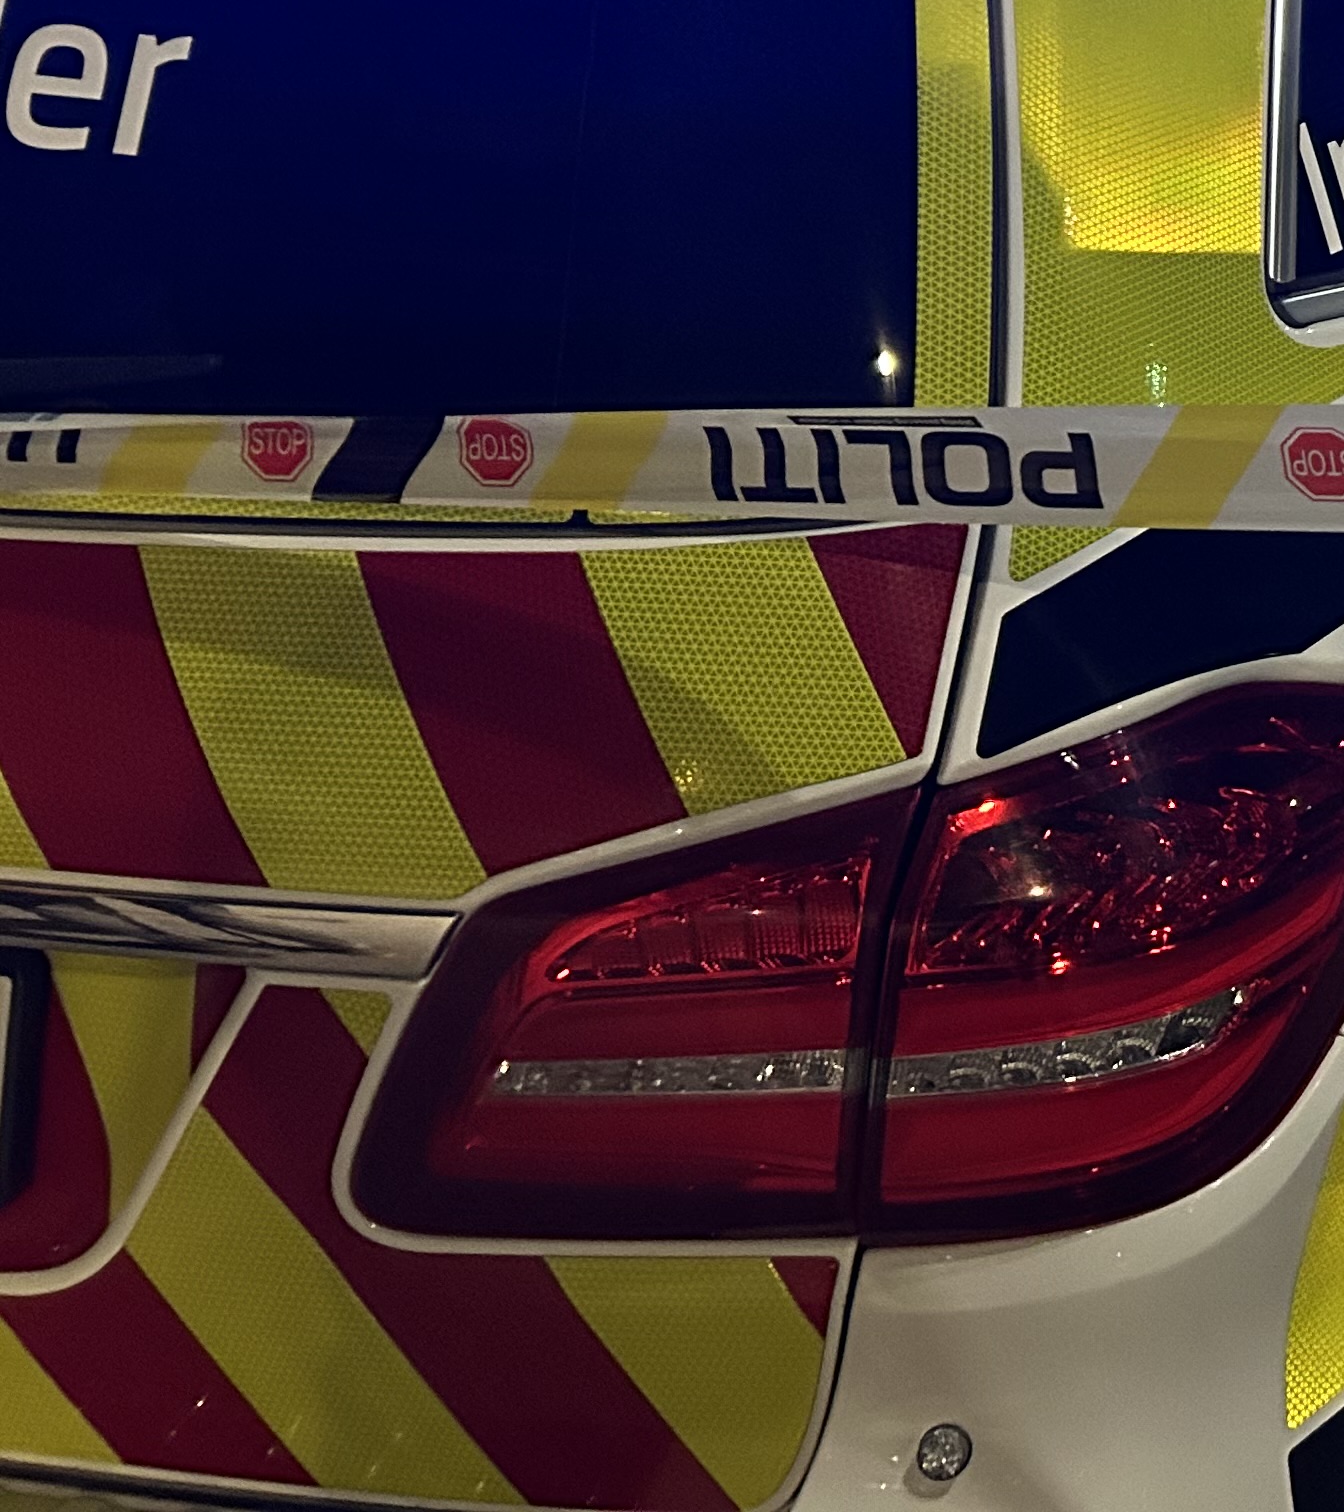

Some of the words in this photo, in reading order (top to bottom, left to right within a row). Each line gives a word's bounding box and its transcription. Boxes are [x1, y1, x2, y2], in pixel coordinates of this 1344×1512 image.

[249, 427, 306, 456] STOP
[469, 433, 526, 462] STOP
[702, 425, 1104, 509] POLITI
